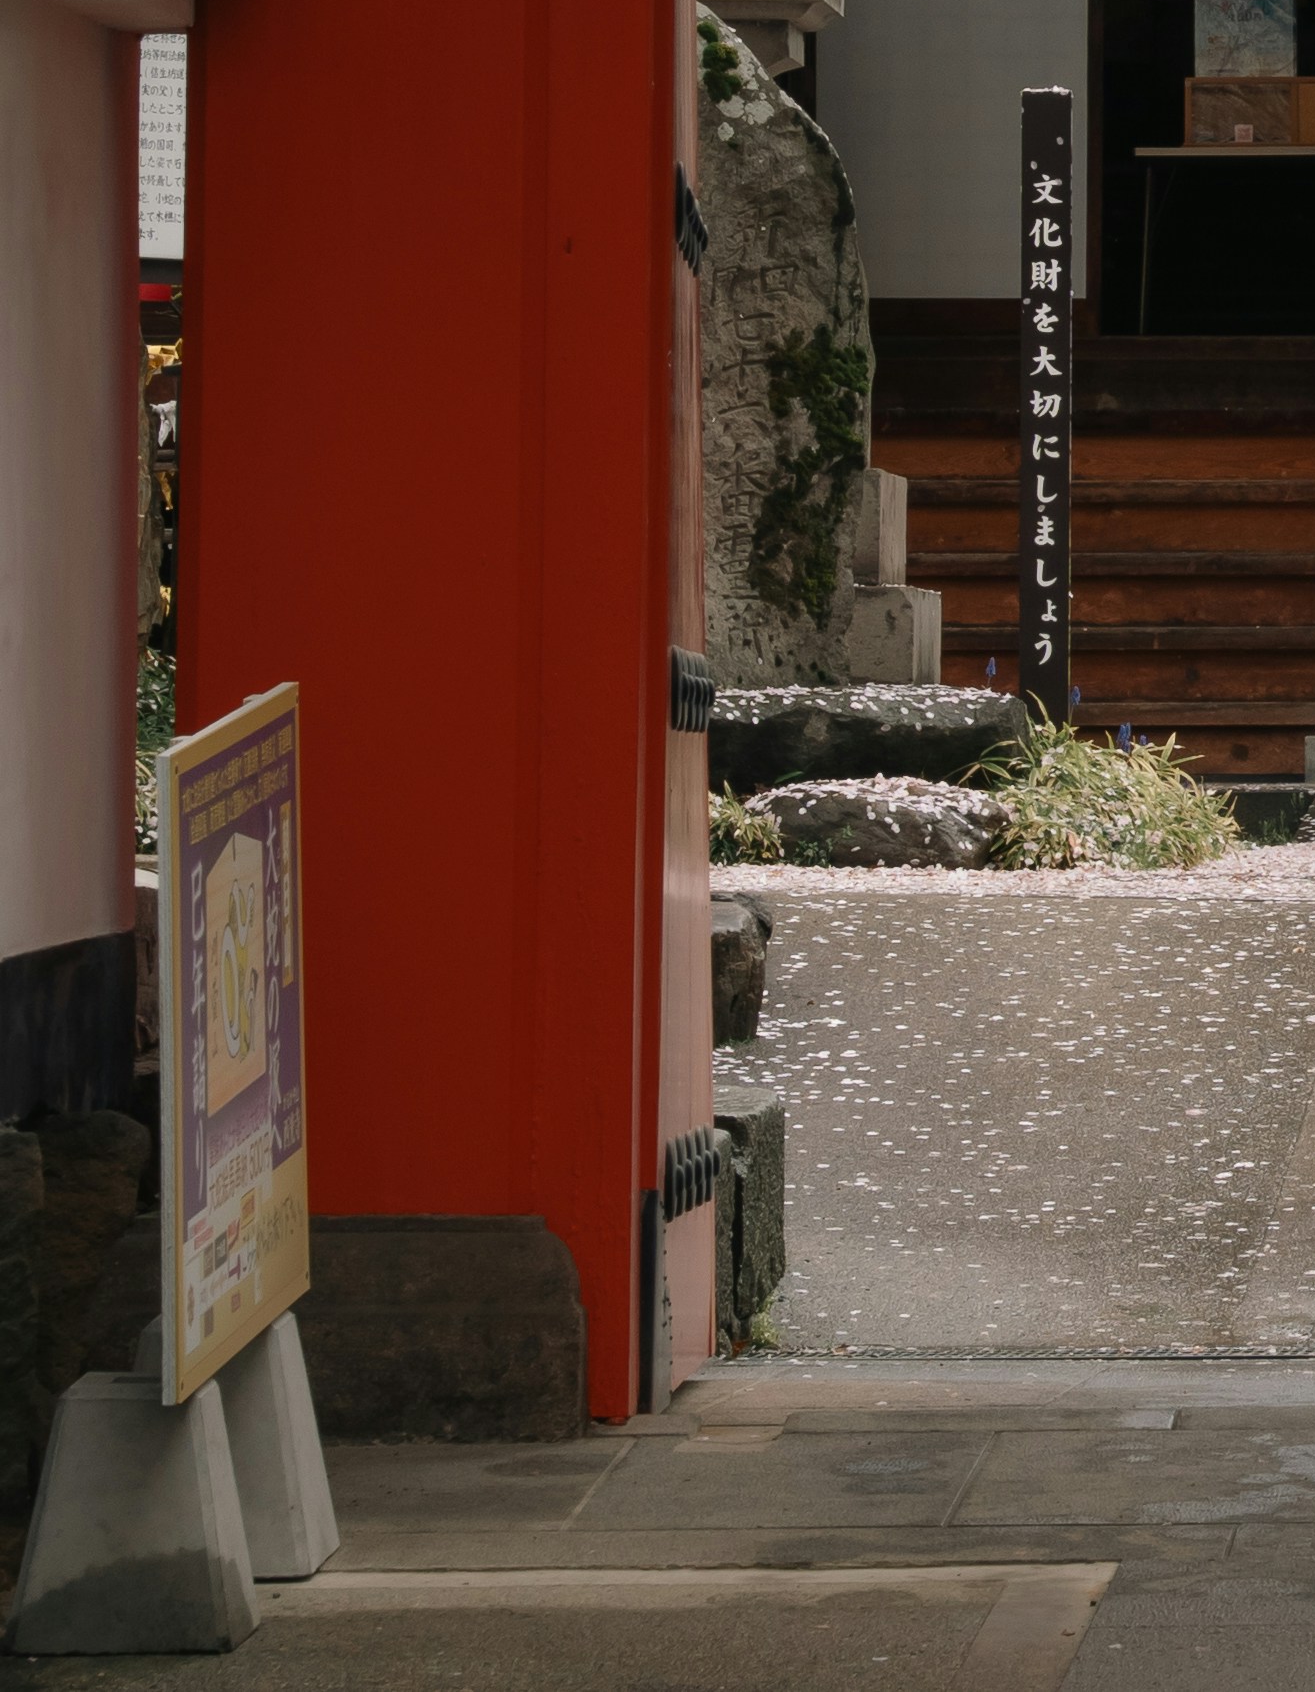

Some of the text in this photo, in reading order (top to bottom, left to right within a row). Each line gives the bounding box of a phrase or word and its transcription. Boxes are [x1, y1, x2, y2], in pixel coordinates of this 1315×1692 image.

[140, 48, 186, 62] 坊等阿法師
[142, 102, 186, 115] したところ
[1029, 174, 1064, 666] 文化財を大切にしましょう
[190, 860, 206, 1202] 巳年詣り
